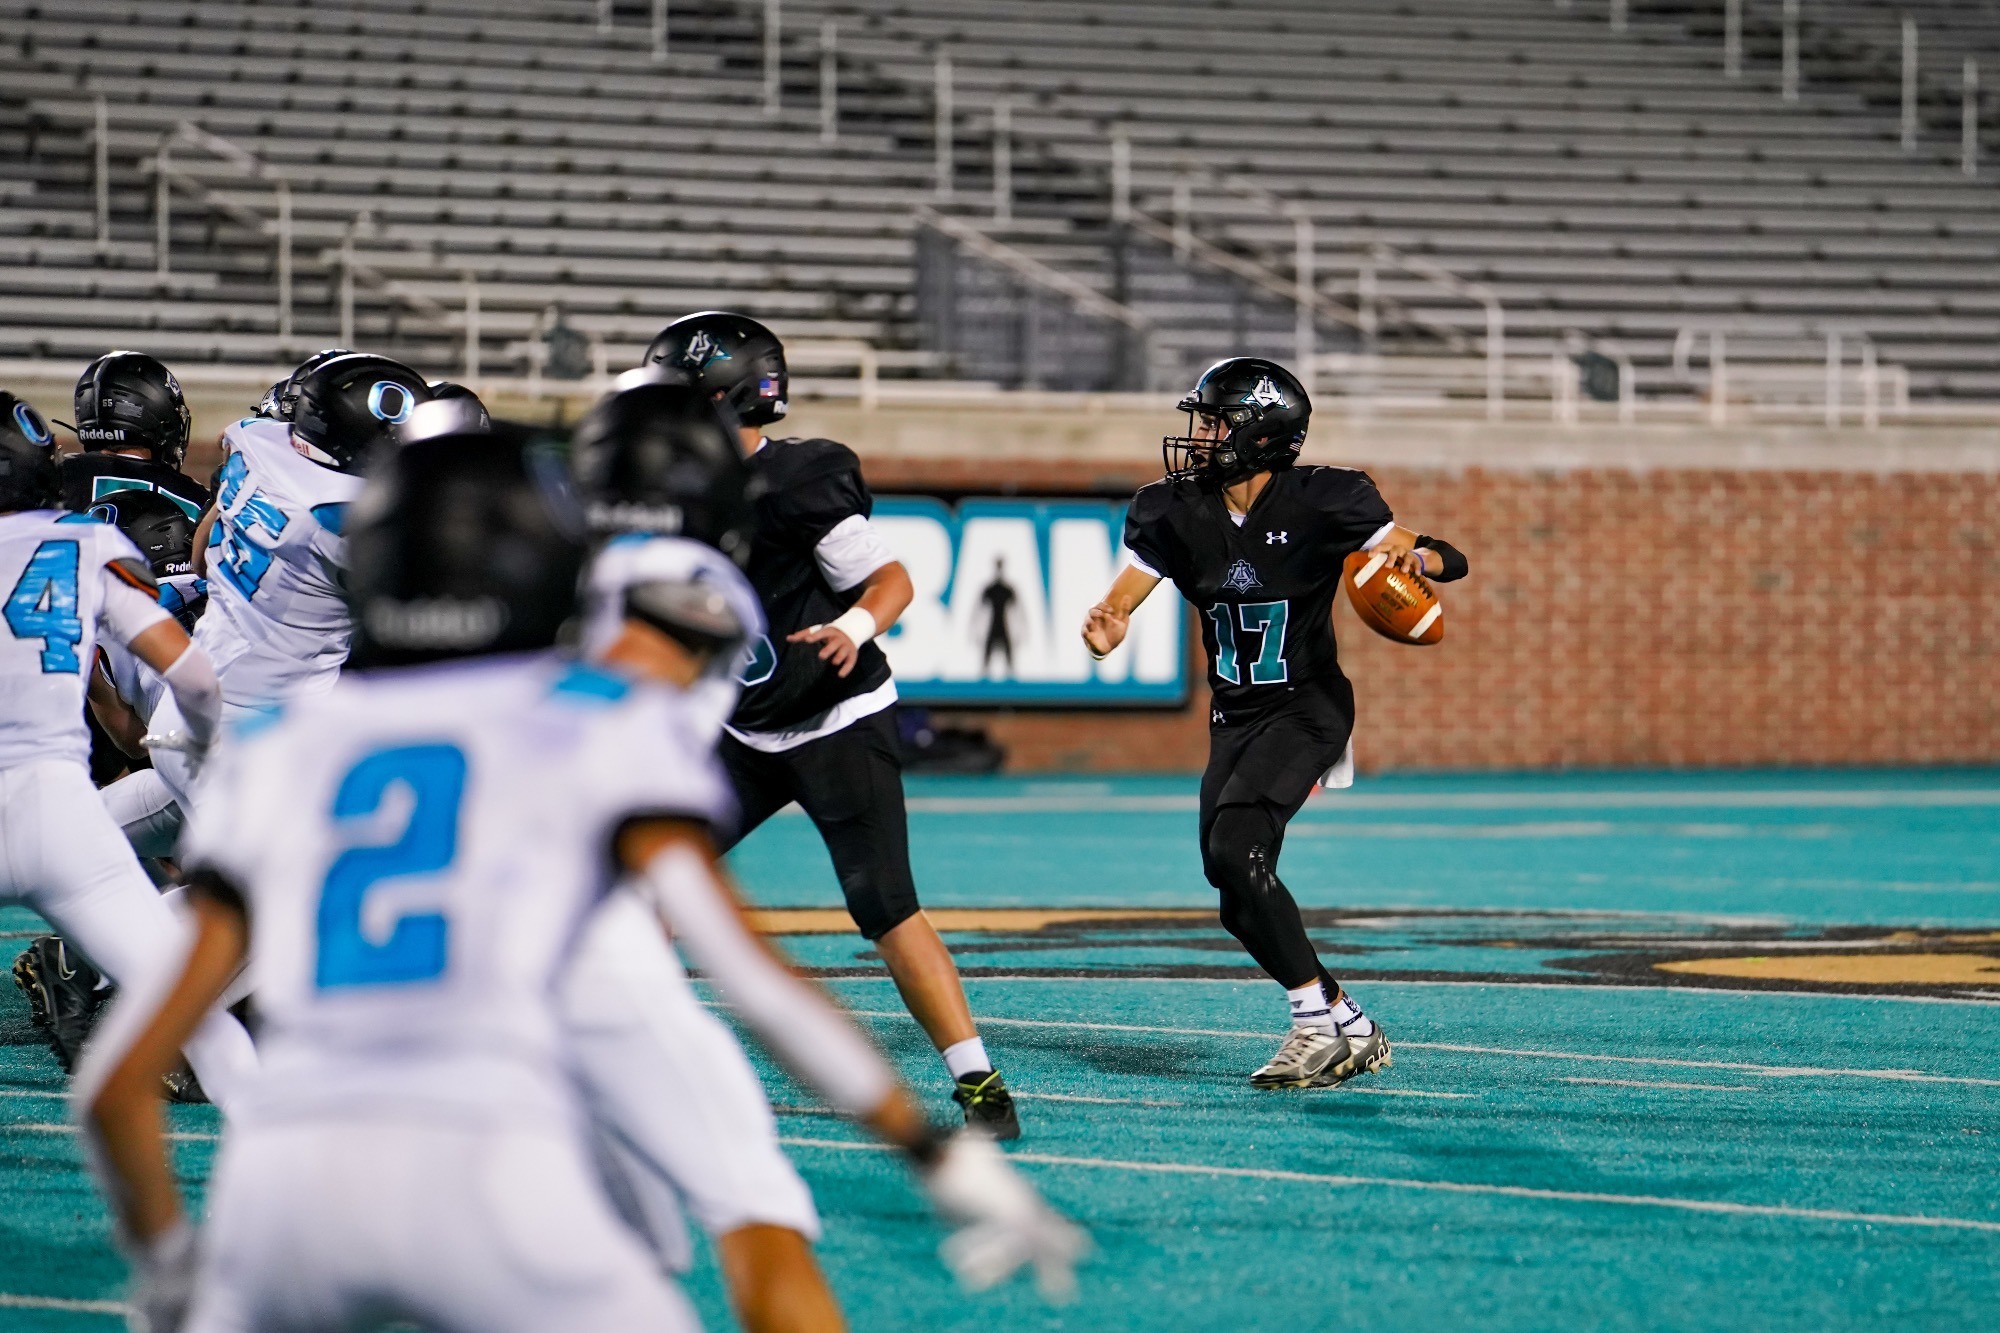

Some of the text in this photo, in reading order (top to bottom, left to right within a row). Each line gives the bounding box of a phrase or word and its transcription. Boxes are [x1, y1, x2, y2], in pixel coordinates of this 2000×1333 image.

[79, 429, 125, 441] Riddell
[1, 539, 83, 675] 4
[1386, 572, 1418, 607] Wilson
[1206, 599, 1289, 686] 17
[315, 744, 467, 989] 2
